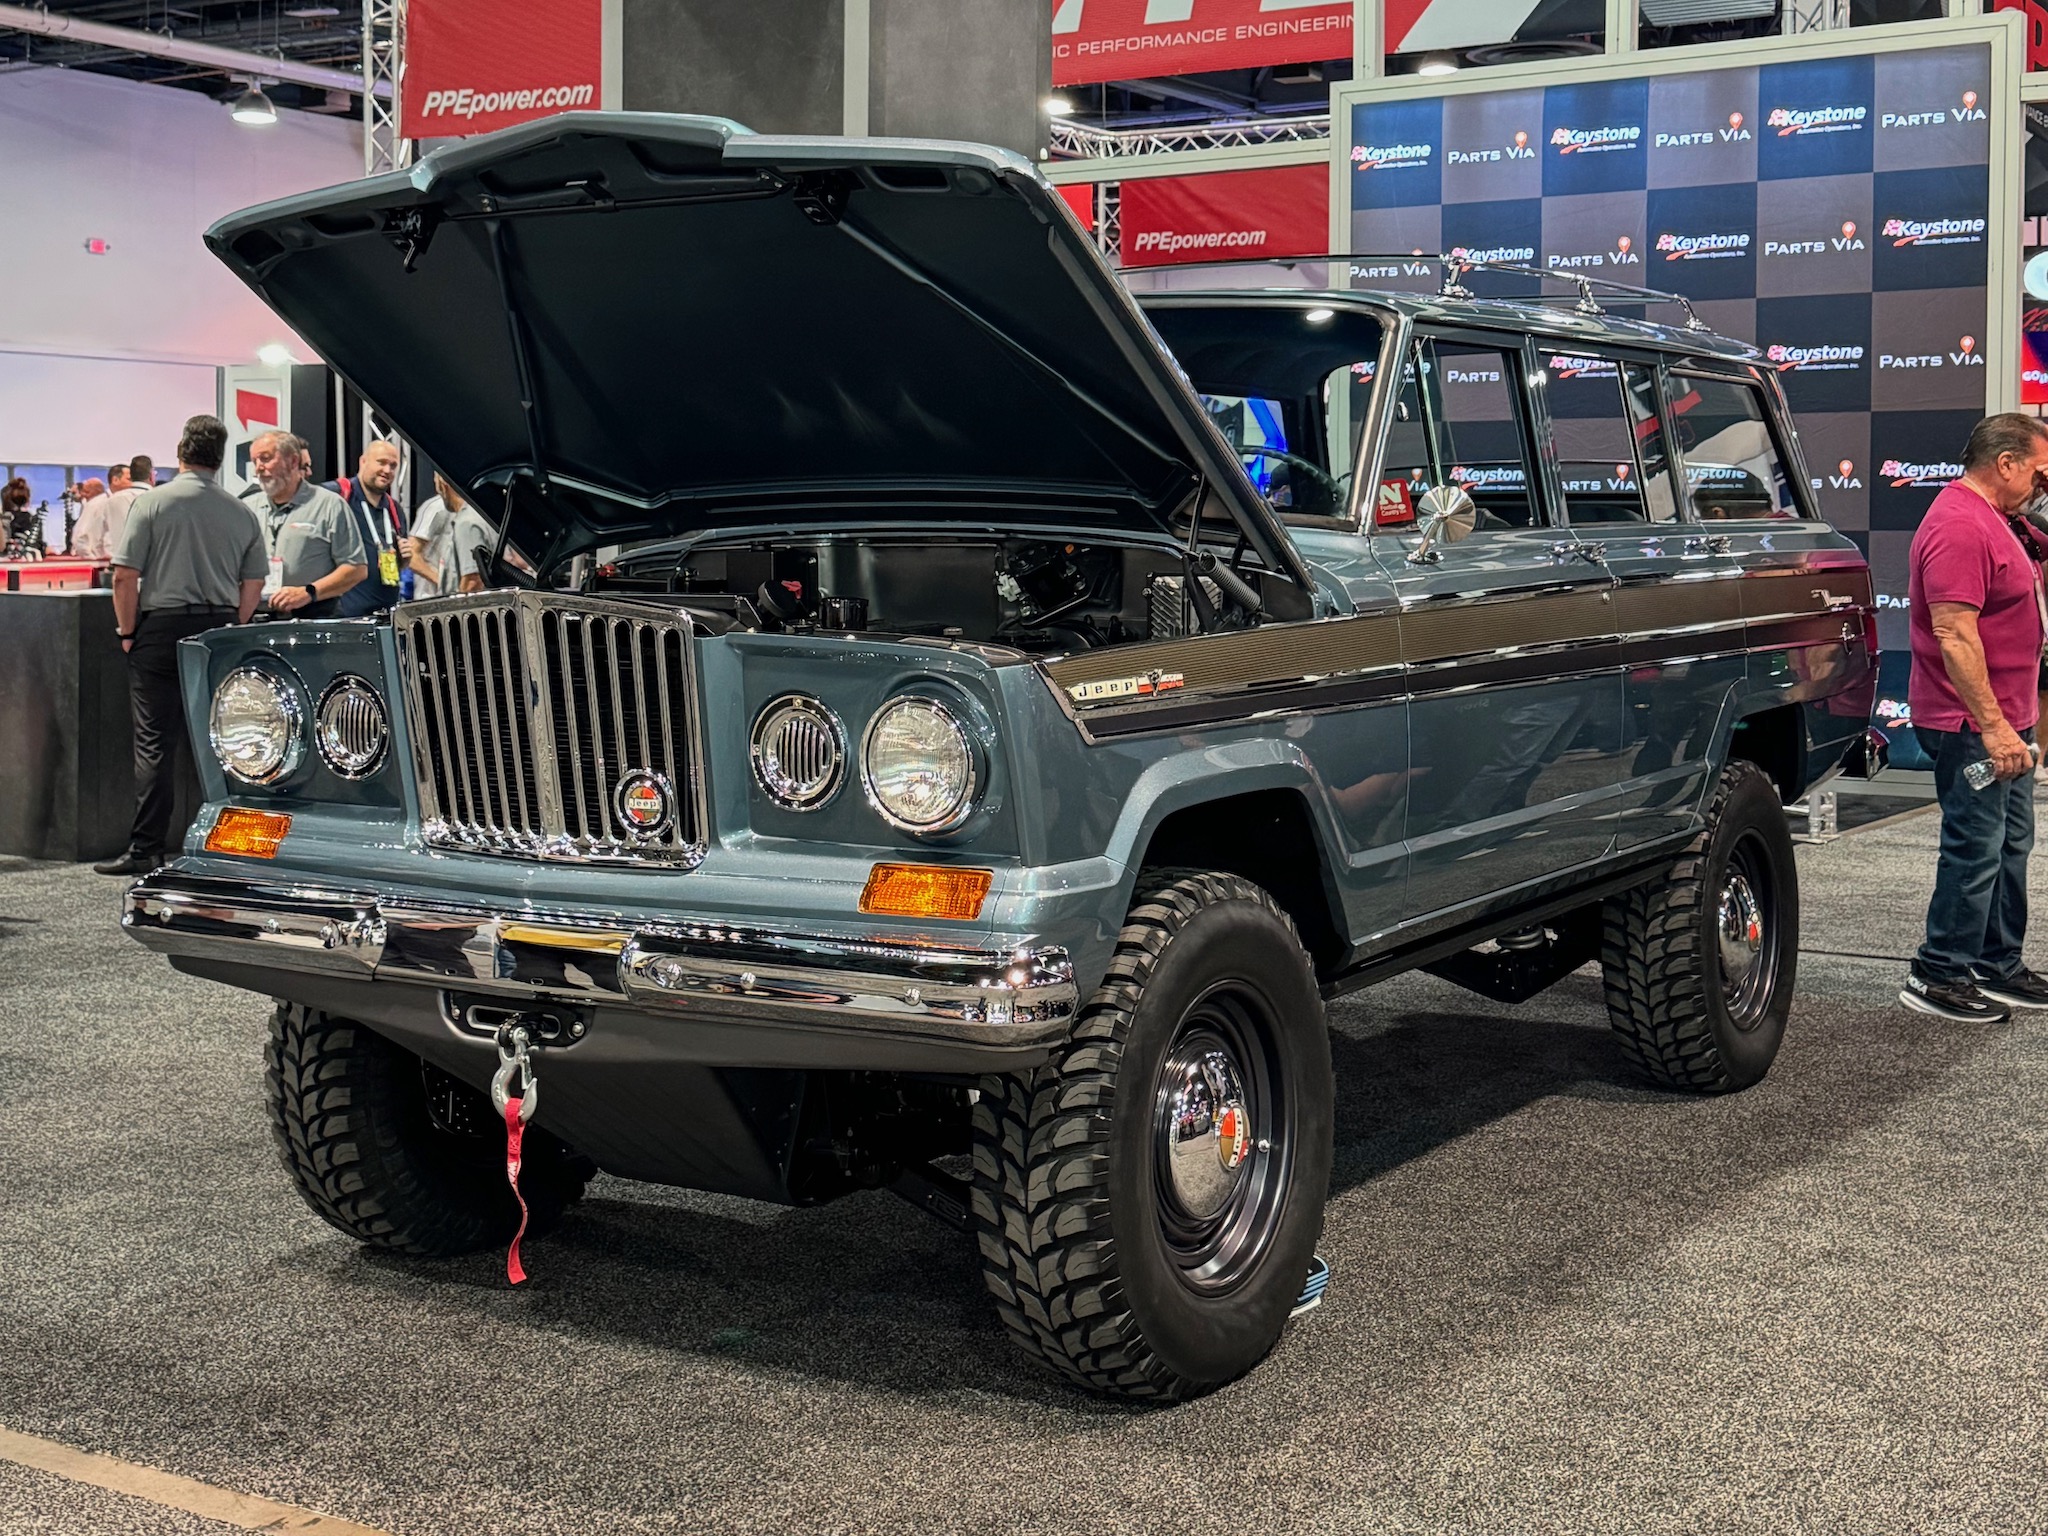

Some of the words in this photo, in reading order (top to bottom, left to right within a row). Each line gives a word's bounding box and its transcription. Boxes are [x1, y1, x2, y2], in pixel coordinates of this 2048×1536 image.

[1077, 28, 1227, 56] PERFORMANCE
[1235, 14, 1354, 39] ENGINEERIN
[422, 84, 594, 119] PPEpower.com
[1784, 106, 1866, 128] Keystone
[1882, 112, 1946, 128] PARTS
[1951, 107, 1987, 122] VIA
[1567, 126, 1641, 147] Keystone
[1655, 132, 1713, 148] PARTS
[1719, 128, 1751, 143] VIA
[1361, 144, 1431, 163] Keystone
[1448, 150, 1501, 165] PARTS
[1506, 146, 1535, 160] VIA
[1899, 218, 1985, 239] Keystone
[1135, 230, 1267, 253] PPEpower.com
[1671, 233, 1750, 253] Keystone
[1765, 241, 1826, 256] PARTS
[1831, 237, 1865, 251] VIA
[1462, 247, 1535, 263] Keystone
[1549, 255, 1604, 268] PARTS
[1608, 251, 1639, 265] VIA
[1350, 265, 1398, 278] PARTS
[1403, 263, 1431, 276] VIA
[1782, 345, 1864, 364] Keystone
[1879, 354, 1943, 369] PARTS
[1949, 352, 1985, 366] VIA
[1447, 370, 1500, 383] PARTS
[1462, 467, 1525, 485] Keyston
[1562, 480, 1601, 491] ARTS
[1607, 478, 1637, 491] VIA
[1829, 475, 1862, 489] VIA
[1379, 483, 1402, 505] N
[1406, 480, 1430, 492] VIA
[1876, 594, 1911, 609] PAR
[1079, 681, 1133, 697] Jeep
[630, 799, 657, 808] Jeep
